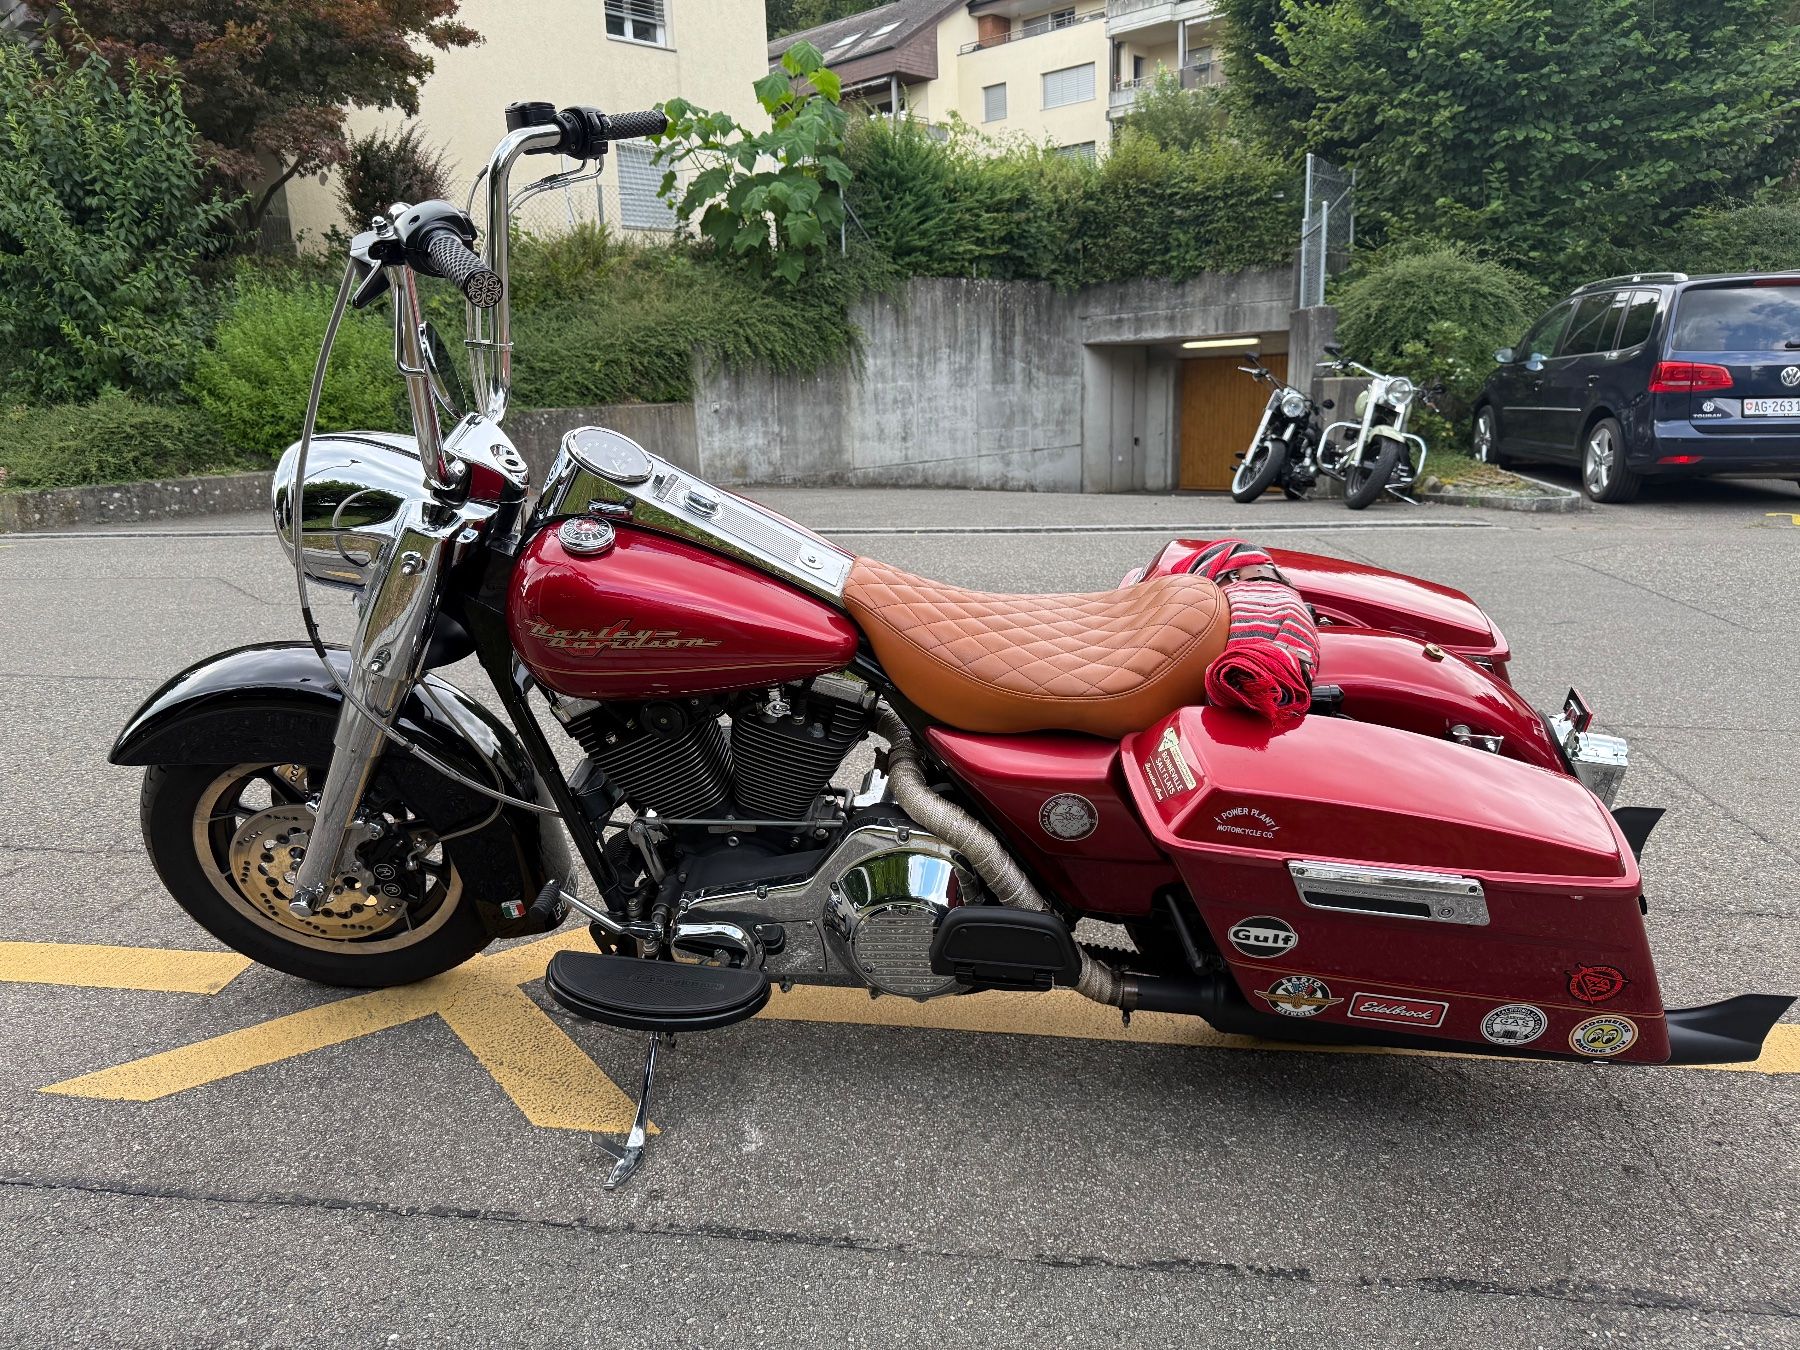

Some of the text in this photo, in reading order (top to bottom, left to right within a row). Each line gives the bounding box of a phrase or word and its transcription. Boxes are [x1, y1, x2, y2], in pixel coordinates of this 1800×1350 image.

[523, 618, 681, 639] Harley
[545, 637, 723, 650] Davidson
[1155, 757, 1176, 795] SALT FLATS
[1161, 751, 1184, 792] BONNEVILLE
[1221, 807, 1276, 827] POWER PLANT
[1216, 824, 1274, 839] MOTORCYCLE CO.
[1232, 929, 1294, 946] Gulf
[1281, 977, 1321, 987] RADIO
[1276, 1005, 1317, 1017] NETWORK
[1359, 1001, 1432, 1020] Edelbrock
[1500, 1018, 1534, 1028] GAS
[1580, 1019, 1631, 1033] MOONEYES
[1575, 1039, 1607, 1053] RACING
